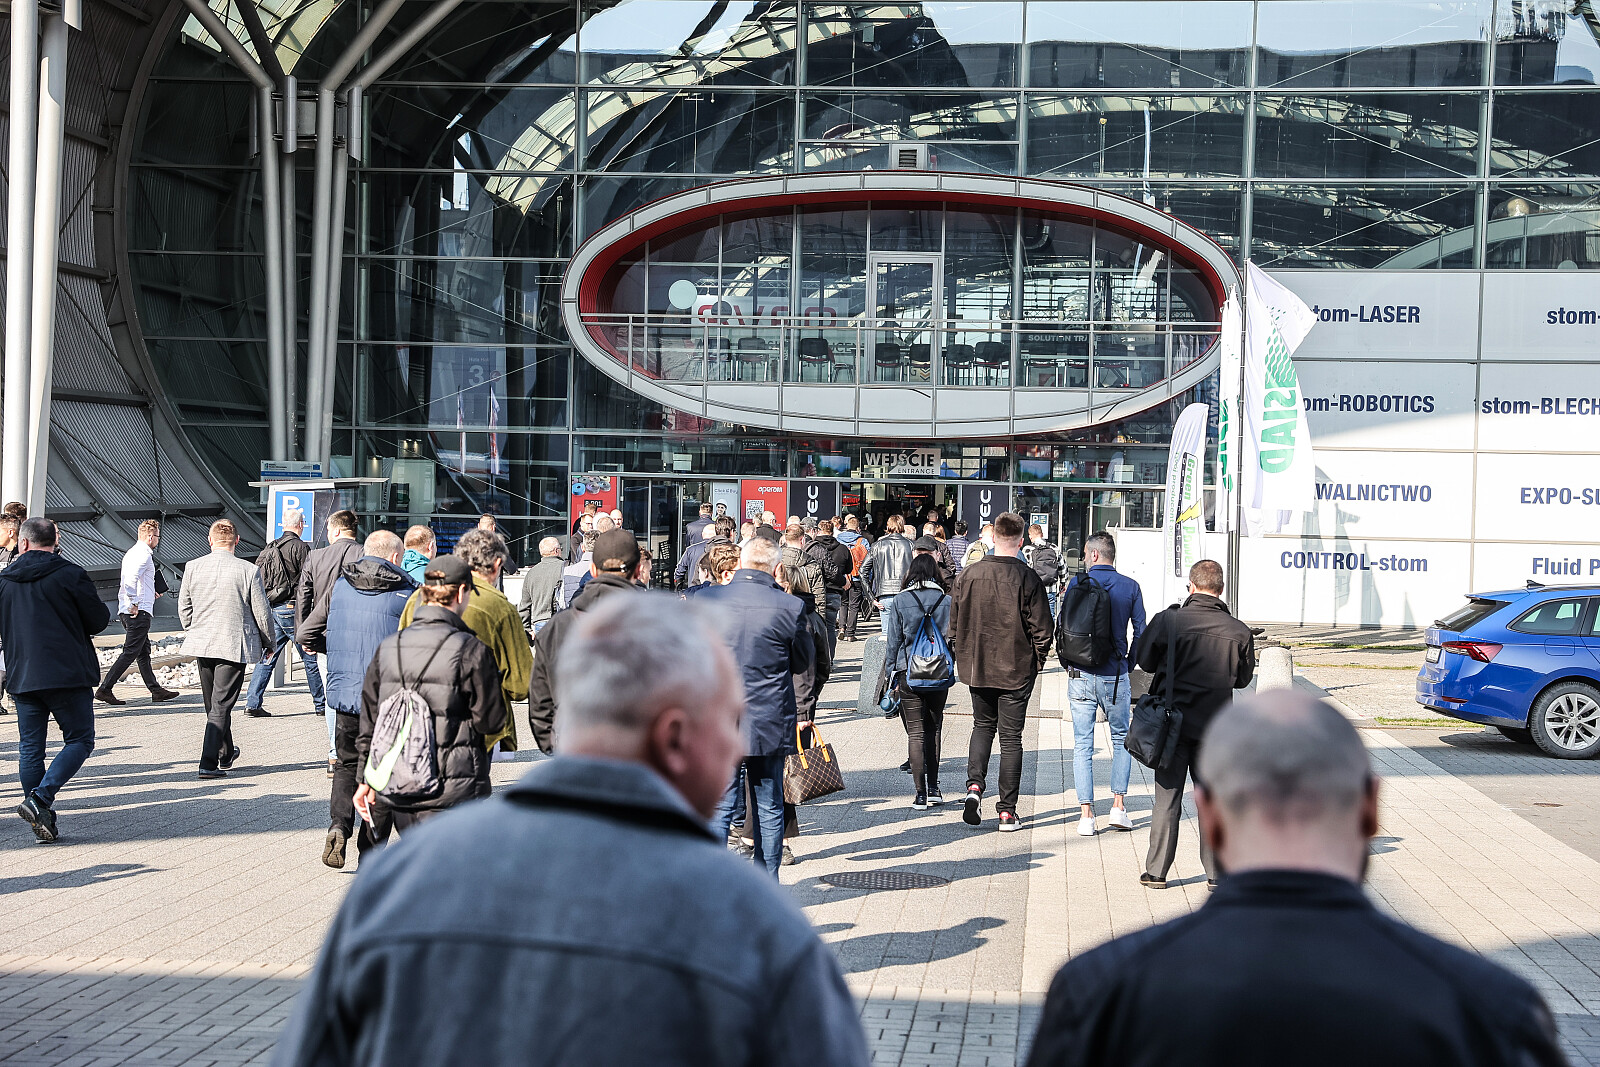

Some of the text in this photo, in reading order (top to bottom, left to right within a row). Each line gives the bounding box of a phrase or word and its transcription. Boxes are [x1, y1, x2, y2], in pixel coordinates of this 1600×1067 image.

[1311, 305, 1420, 323] tom-LASER
[1303, 395, 1434, 412] om-ROBOTICS
[865, 450, 935, 467] WEJŚCIE
[1184, 458, 1195, 501] Green
[1314, 483, 1432, 502] WALNICTWO
[283, 496, 300, 514] P
[1280, 551, 1429, 572] CONTROL-stom
[1533, 558, 1581, 575] Fluid
